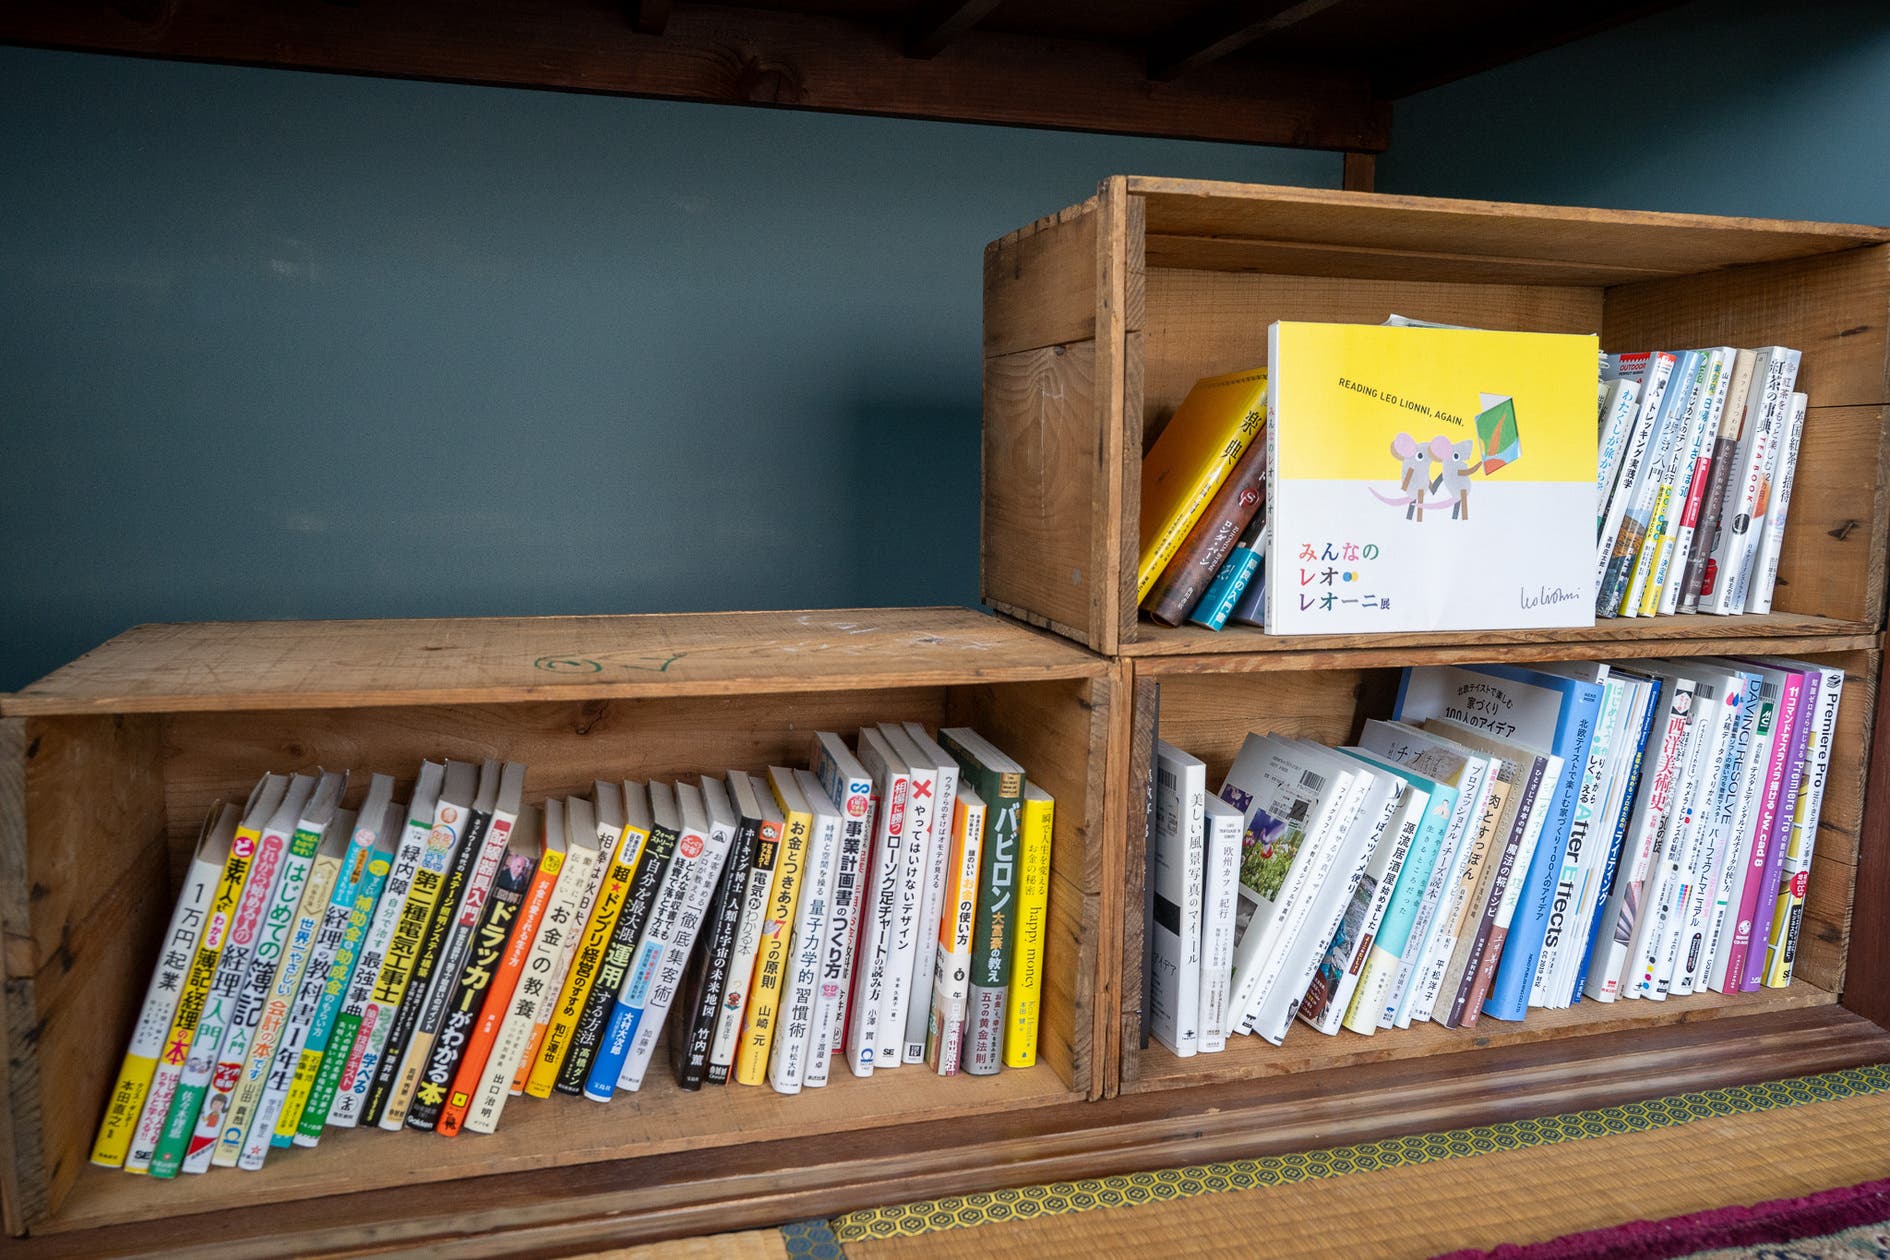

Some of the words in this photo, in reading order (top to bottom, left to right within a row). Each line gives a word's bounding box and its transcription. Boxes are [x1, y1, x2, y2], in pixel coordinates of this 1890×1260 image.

[1338, 377, 1378, 398] READING
[1379, 391, 1398, 405] LEO
[1399, 399, 1432, 418] LIONNI,
[1434, 410, 1465, 427] AGAIN.
[1620, 363, 1646, 371] OUTDOOR
[1757, 360, 1785, 435] 紅茶の事典
[1222, 410, 1262, 465] 楽典
[1624, 402, 1656, 489] トレッキング実践学
[1755, 437, 1766, 459] TEA
[1747, 465, 1760, 502] BOOK
[1299, 542, 1380, 561] みんなの
[1299, 592, 1391, 611] レオーニ展
[1445, 707, 1516, 738] 100人のアイデア
[1457, 684, 1514, 709] 北欧テイストで楽しむ
[1466, 696, 1500, 715] 家づくり
[1738, 680, 1761, 747] DAVINCI
[1818, 693, 1838, 760] Premiere
[1650, 718, 1686, 812] 西洋美術史
[1706, 714, 1732, 805] 入稿データのつくりかた
[1720, 750, 1745, 824] RESOLVE
[1785, 761, 1804, 810] Premiere
[1813, 762, 1826, 788] Pro
[932, 776, 952, 889] ウラからのぞけばオモテが見える
[1039, 806, 1051, 896] 一瞬で人生を変える
[1347, 802, 1395, 894] にっぽんツバメ便り
[1426, 766, 1482, 899] プロフェッショナル・チーズ読本
[1463, 793, 1501, 881] 肉とすっぽん
[1535, 719, 1589, 921] 北欧テイストで楽しむ家づくり100人のアイデア
[1567, 804, 1592, 863] After
[1781, 814, 1793, 832] Pro
[388, 844, 422, 896] 緑内障
[688, 851, 713, 901] プロが教える
[698, 852, 722, 908] お客を集める
[730, 829, 755, 893] ホーキング博士
[815, 824, 834, 896] 時間と空間を操る
[898, 805, 926, 950] やってはいけないデザイン
[987, 802, 1021, 982] バビロン大富豪の教え
[1025, 845, 1038, 896] お金の秘密
[1187, 793, 1203, 965] 美しい風景写真のマイ・ルール
[1219, 847, 1233, 920] 欧州カフェ紀行
[1368, 821, 1416, 930] 源流居酒屋始めました
[1400, 825, 1432, 914] 生きるところだった
[1690, 829, 1719, 927] パーフェクトマニュアル
[374, 897, 398, 949] 自分で治す
[648, 857, 685, 938] 経費で落とす方法
[661, 861, 696, 941] どんな領収書でも
[738, 872, 768, 956] 電気がわかる本
[761, 821, 806, 989] お金とつきあう7つの原則
[824, 820, 862, 979] 事業計画書のつくり方
[869, 836, 901, 1001] ローソク足チャートの読み方
[957, 850, 976, 945] 頭のいいお金の使い方
[1024, 906, 1042, 946] happy
[1544, 865, 1579, 948] Effects
[158, 883, 204, 992] 1万円起業
[229, 861, 306, 1055] はじめての簿記入門
[374, 869, 441, 1004] 第二種電気工事士
[513, 900, 577, 1020] 「お金」の教養
[651, 904, 703, 1008] 「徹底集客術」
[702, 898, 739, 1017] 人類と宇宙の未来地図
[789, 899, 827, 1038] 量子力学的習慣術
[1021, 948, 1037, 990] money
[249, 918, 314, 1081] 世界一やさしい会計の本です
[269, 906, 349, 1091] 経理の教科書1年生
[345, 951, 383, 1016] 最強事典
[416, 901, 518, 1106] ドラッカーがわかる本
[1424, 959, 1445, 1001] 平松洋子
[690, 1027, 710, 1066] 竹内薫
[975, 992, 992, 1064] 五つの黄金法則
[108, 1079, 135, 1128] 本田直之
[480, 1073, 505, 1118] 出口治明
[569, 1048, 591, 1085] 高橋ダン
[150, 1073, 178, 1144] はじめての人でも
